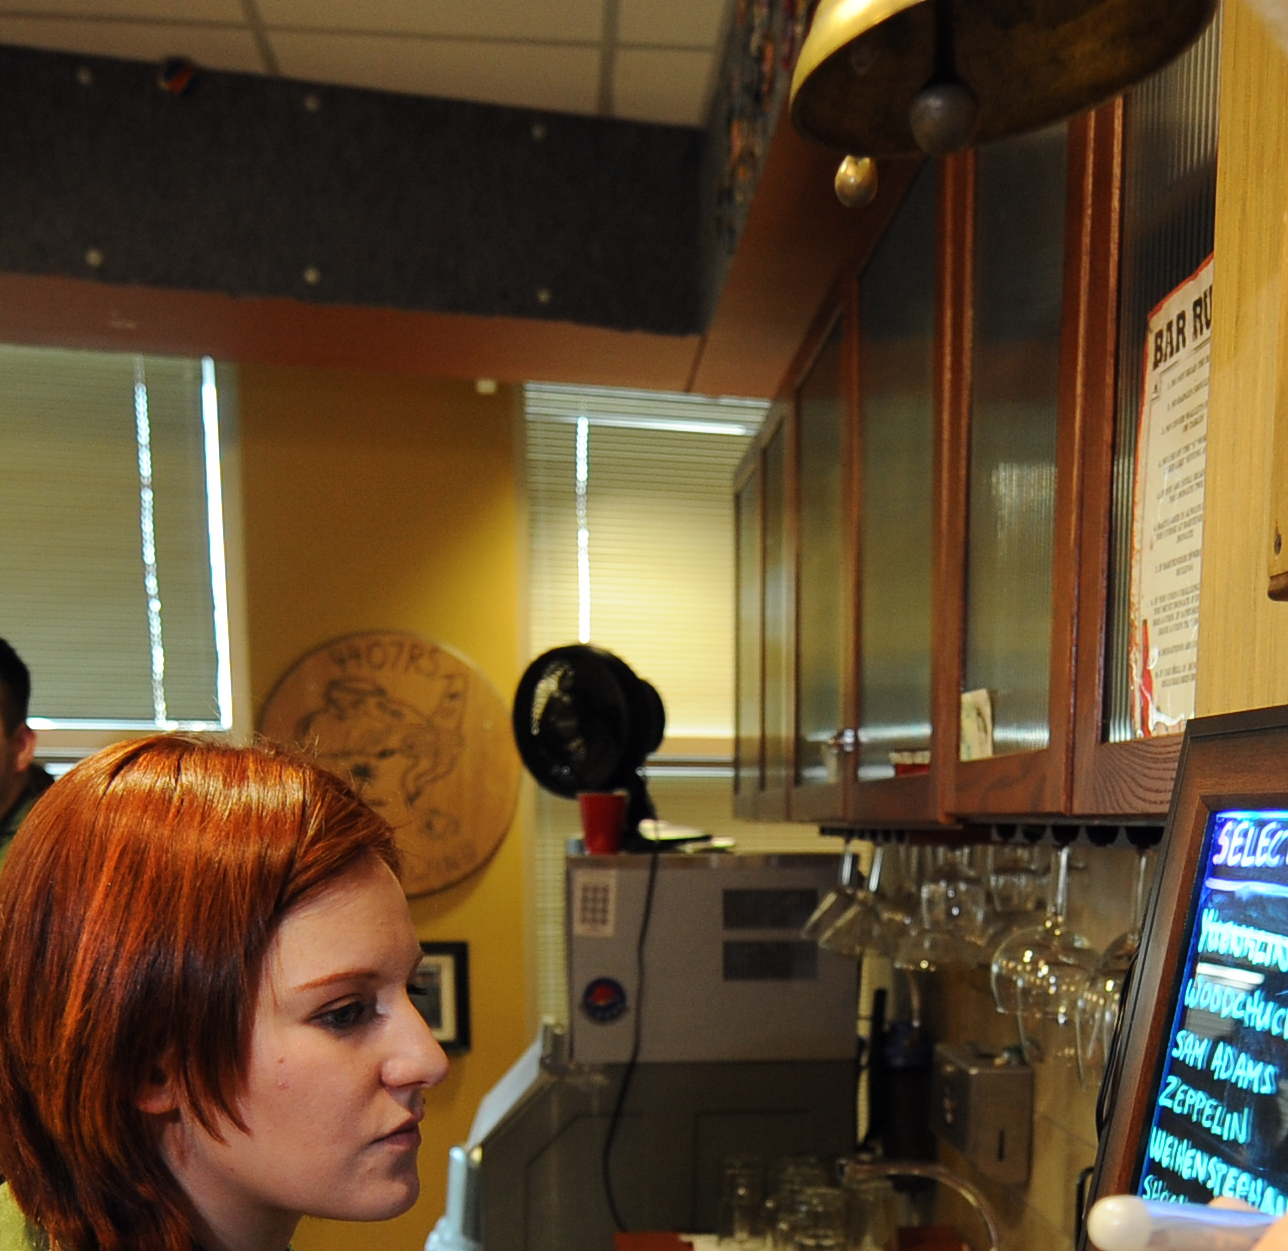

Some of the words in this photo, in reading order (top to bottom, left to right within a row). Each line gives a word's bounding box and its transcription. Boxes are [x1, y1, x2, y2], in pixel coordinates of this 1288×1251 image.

[1153, 309, 1186, 371] BAR
[1171, 1029, 1211, 1071] SAM
[1211, 1041, 1279, 1095] ADAMS
[1159, 1075, 1251, 1144] ZEPPELIN
